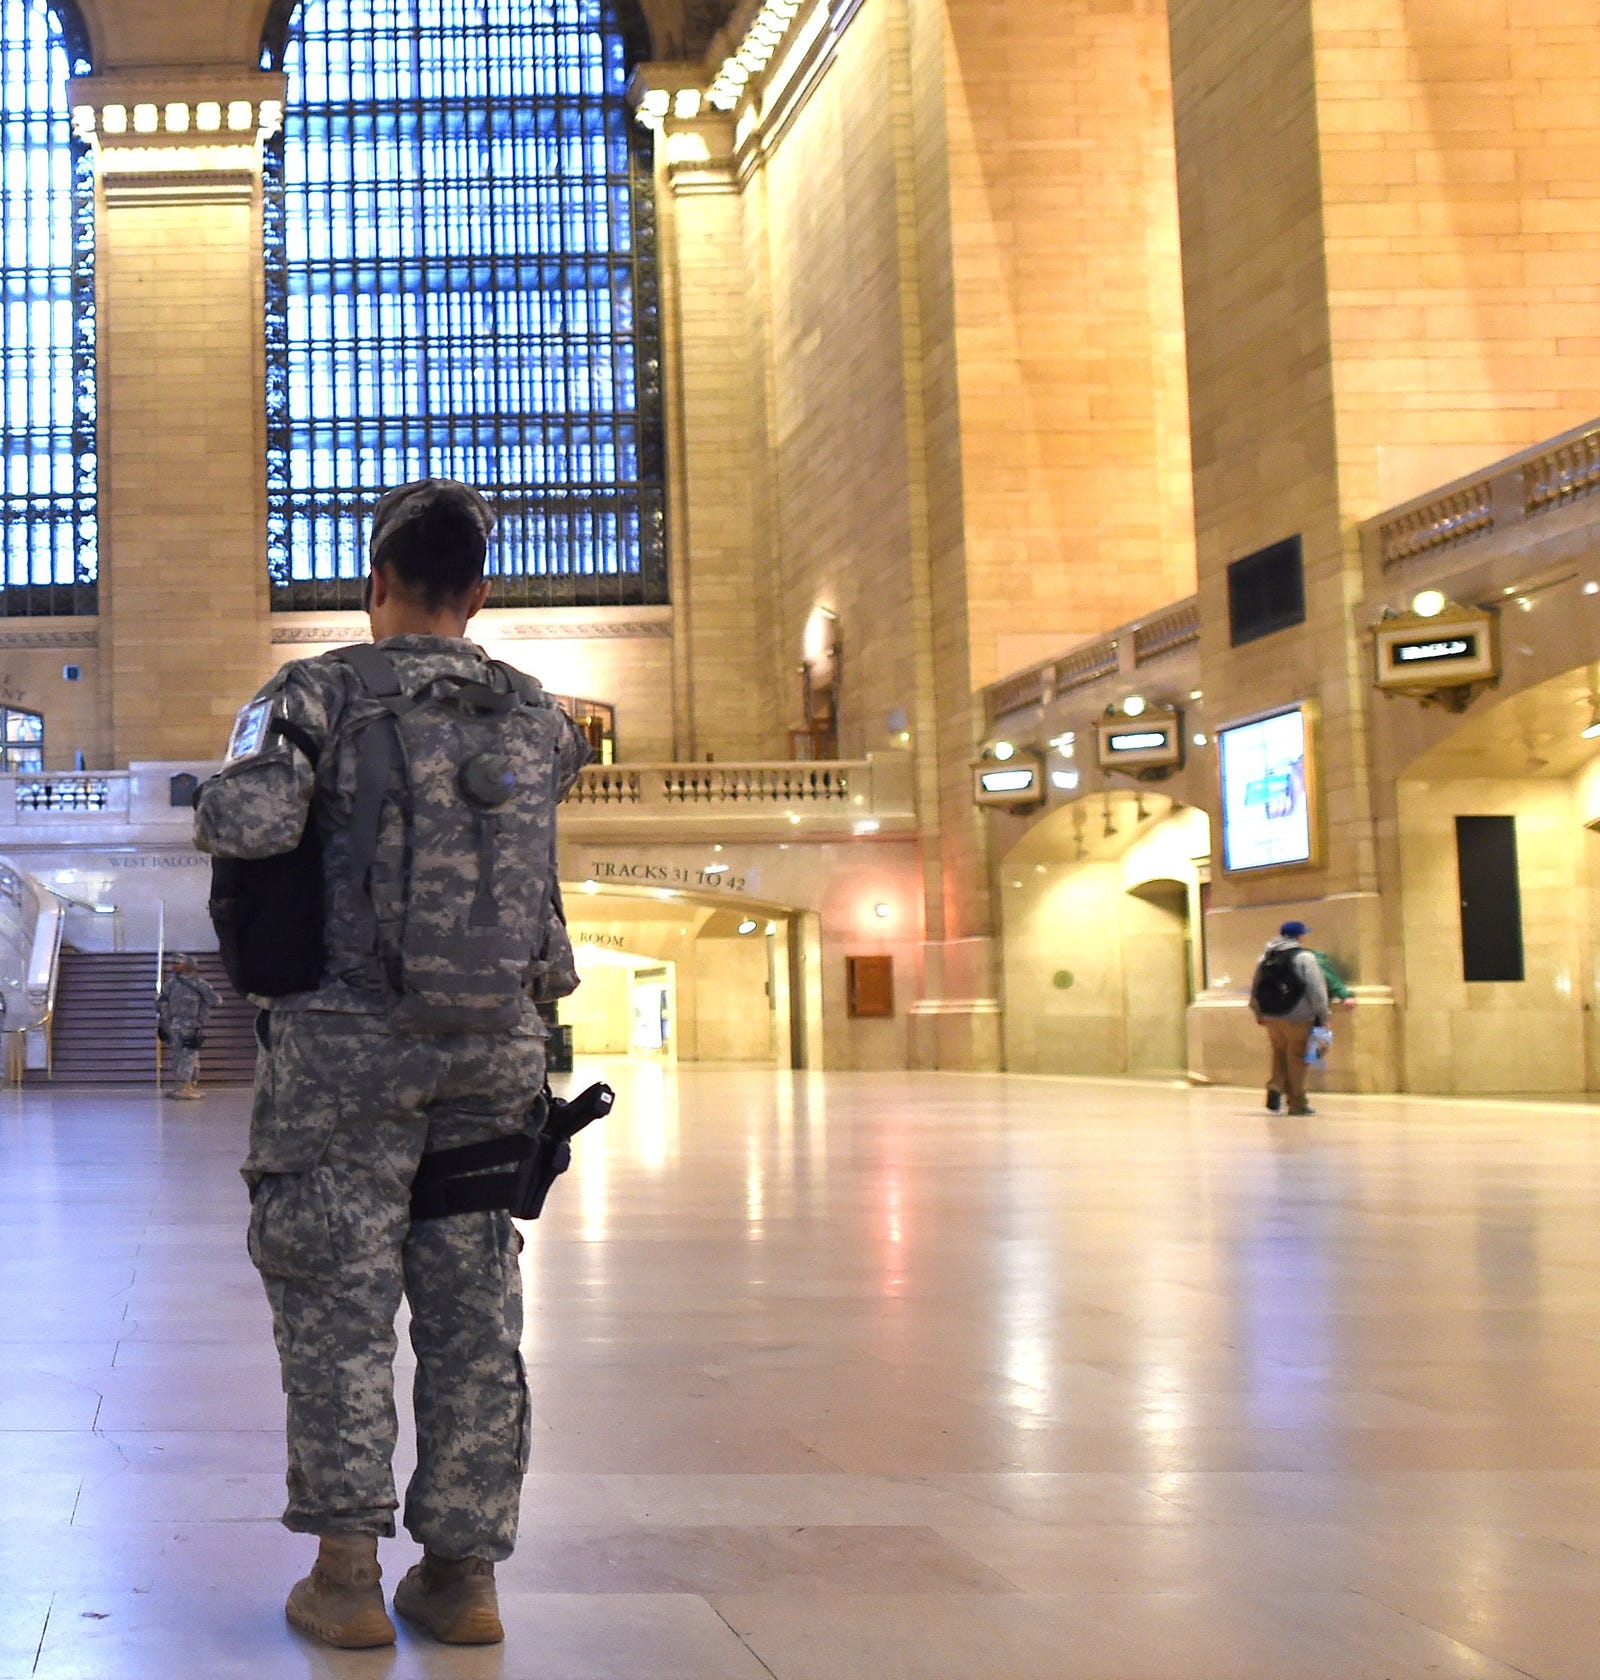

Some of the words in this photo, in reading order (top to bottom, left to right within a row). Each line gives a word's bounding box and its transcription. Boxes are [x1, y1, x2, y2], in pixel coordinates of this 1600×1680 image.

[109, 856, 146, 868] WEST
[592, 861, 668, 881] TRACKS
[672, 869, 689, 883] 31
[696, 870, 722, 887] TO
[726, 876, 746, 892] 42
[580, 931, 625, 947] ROOM
